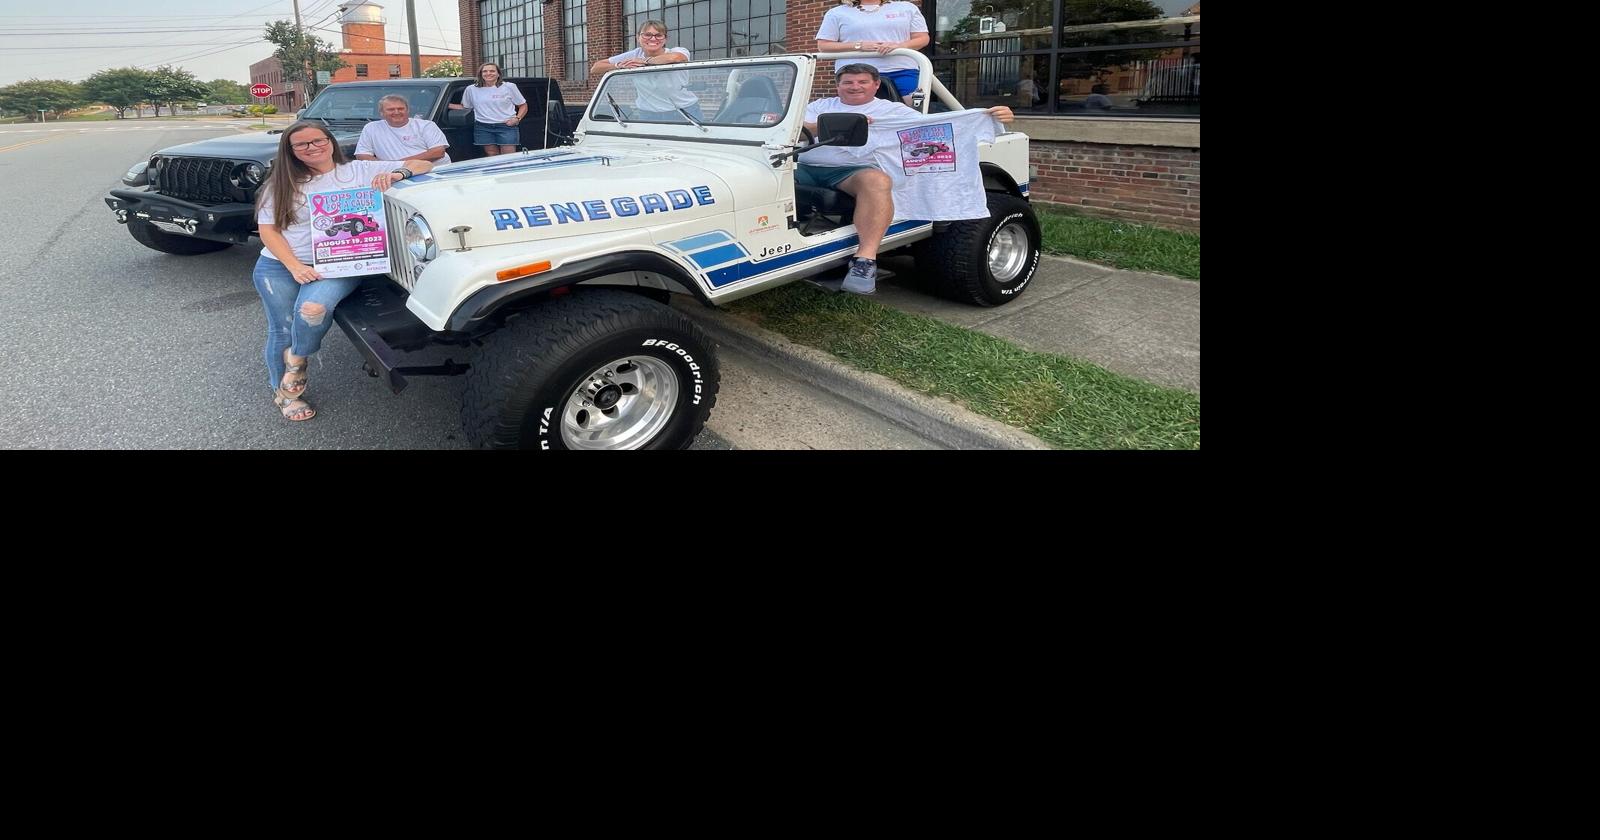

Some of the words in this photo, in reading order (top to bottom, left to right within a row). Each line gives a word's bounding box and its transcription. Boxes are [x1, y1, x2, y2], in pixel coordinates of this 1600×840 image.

[323, 193, 351, 204] TOPS
[356, 191, 375, 199] OFF
[351, 199, 376, 208] CAUSE
[490, 186, 715, 231] RENEGADE
[760, 243, 792, 257] Jeep
[641, 338, 704, 405] BFGoodrich
[539, 407, 554, 435] T/A
